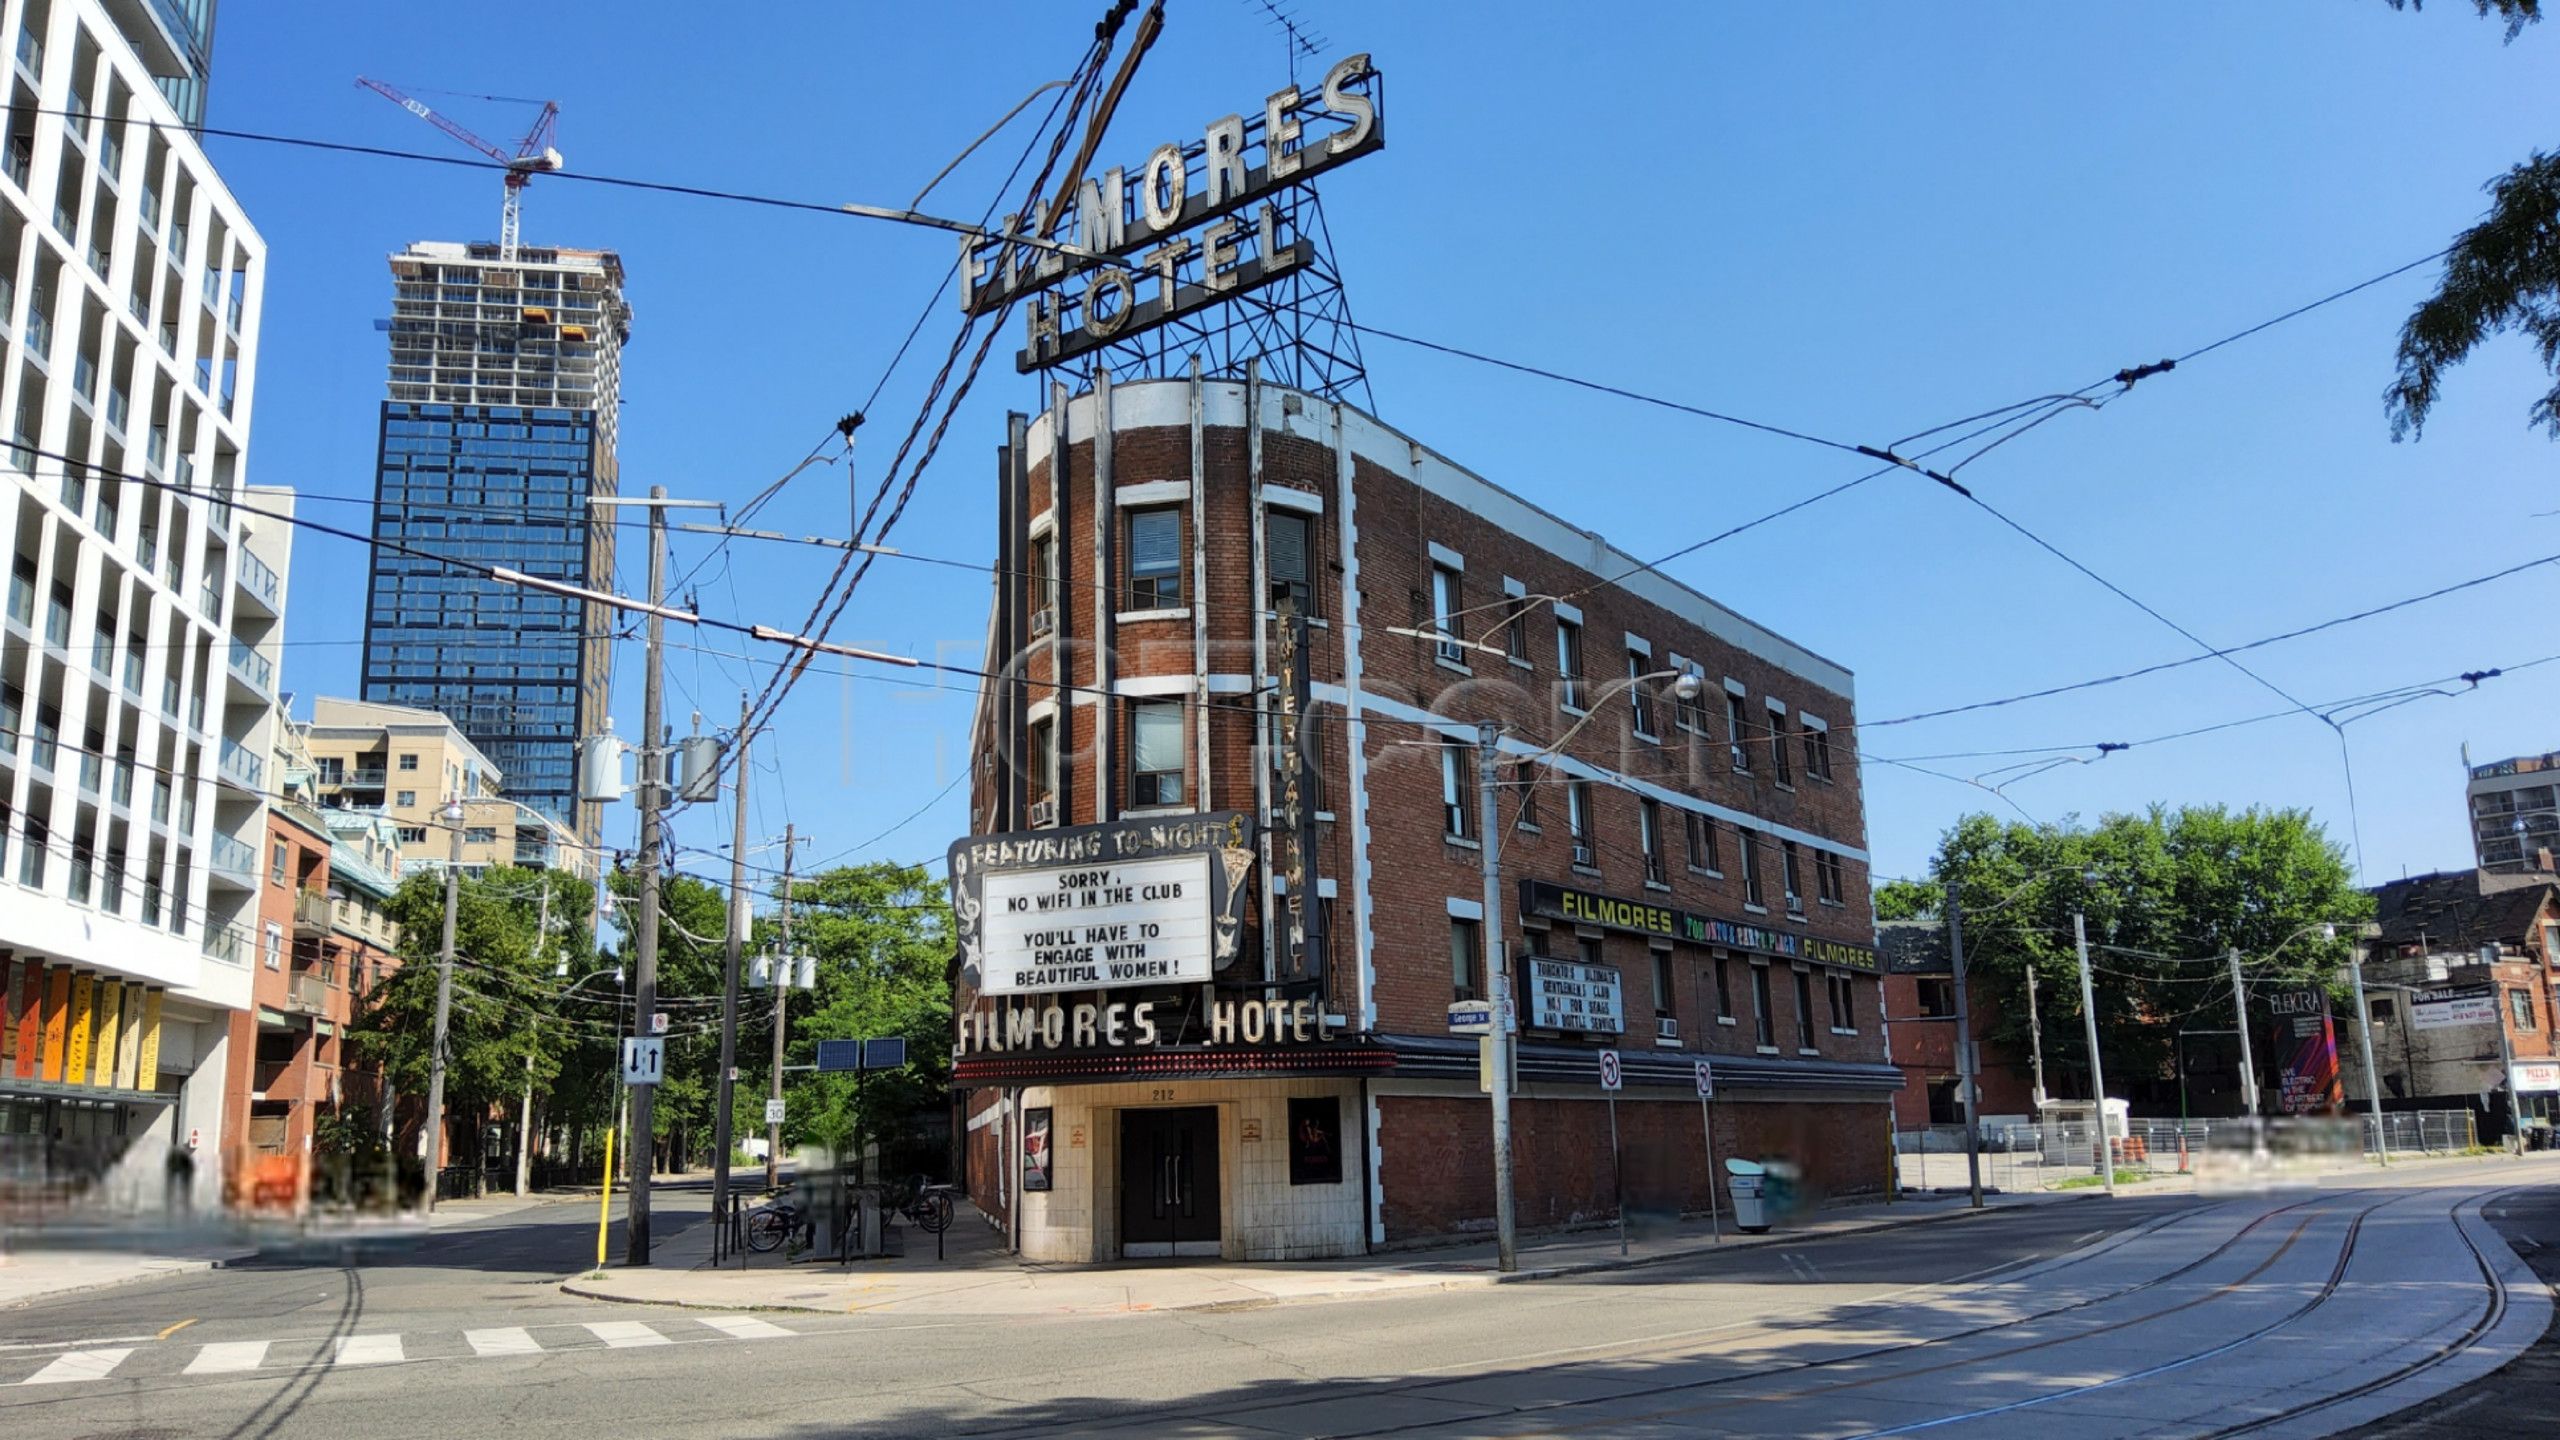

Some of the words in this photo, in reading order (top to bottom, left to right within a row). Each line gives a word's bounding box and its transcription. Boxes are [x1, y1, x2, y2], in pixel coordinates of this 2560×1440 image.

[960, 53, 1375, 313] FILMORES
[1026, 203, 1296, 365] HOTEL
[971, 831, 1101, 874] FEATURING
[1113, 821, 1227, 855] TO-NIGHT
[1008, 897, 1028, 911] NO
[1037, 892, 1072, 909] WIFI
[1081, 889, 1096, 906] IN
[1103, 887, 1134, 904] THE
[1142, 883, 1183, 900] CLUB
[1562, 891, 1673, 934] FILMORES
[1024, 931, 1075, 947] YOU'LL
[1086, 926, 1129, 943] HAVE
[1141, 923, 1160, 939] TO
[1035, 947, 1094, 965] ENGAGE
[1105, 944, 1146, 960] WITH
[1803, 937, 1875, 969] FILMORES
[1015, 966, 1100, 986] BEAUTIFUL
[1593, 985, 1610, 999] CLUB
[2271, 991, 2321, 1014] ELEKTRA
[1570, 998, 1583, 1013] FOR
[958, 1002, 1156, 1057] FILMORES
[1212, 1001, 1336, 1045] HOTEL
[1453, 1013, 1477, 1025] George
[1544, 1012, 1558, 1026] AND
[1153, 1089, 1175, 1100] 212
[769, 1108, 783, 1119] 30
